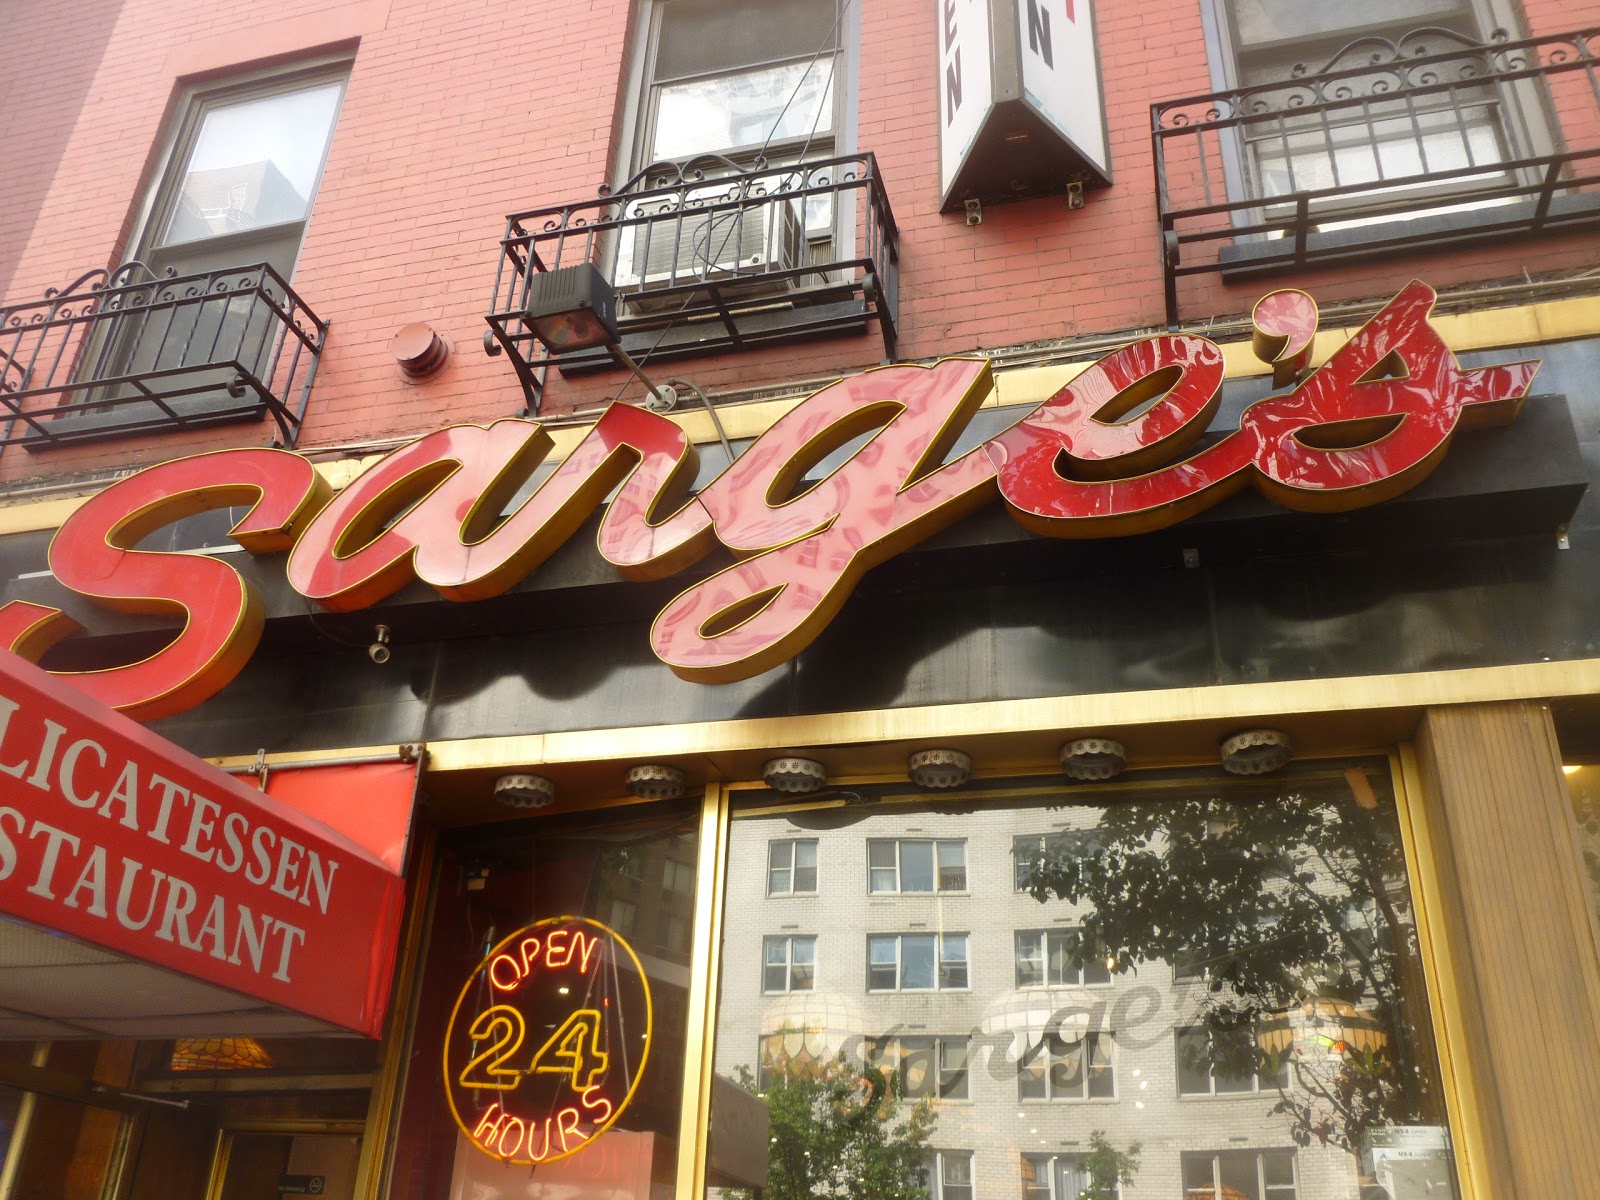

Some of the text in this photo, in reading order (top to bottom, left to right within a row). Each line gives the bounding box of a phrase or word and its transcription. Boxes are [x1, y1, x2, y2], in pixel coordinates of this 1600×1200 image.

[0, 278, 1543, 715] Sarge's
[0, 694, 339, 914] LICATESSEN
[0, 806, 306, 983] STAURANT
[490, 930, 598, 990] OPEN
[459, 1004, 609, 1092] 24
[473, 1084, 612, 1161] HOURS
